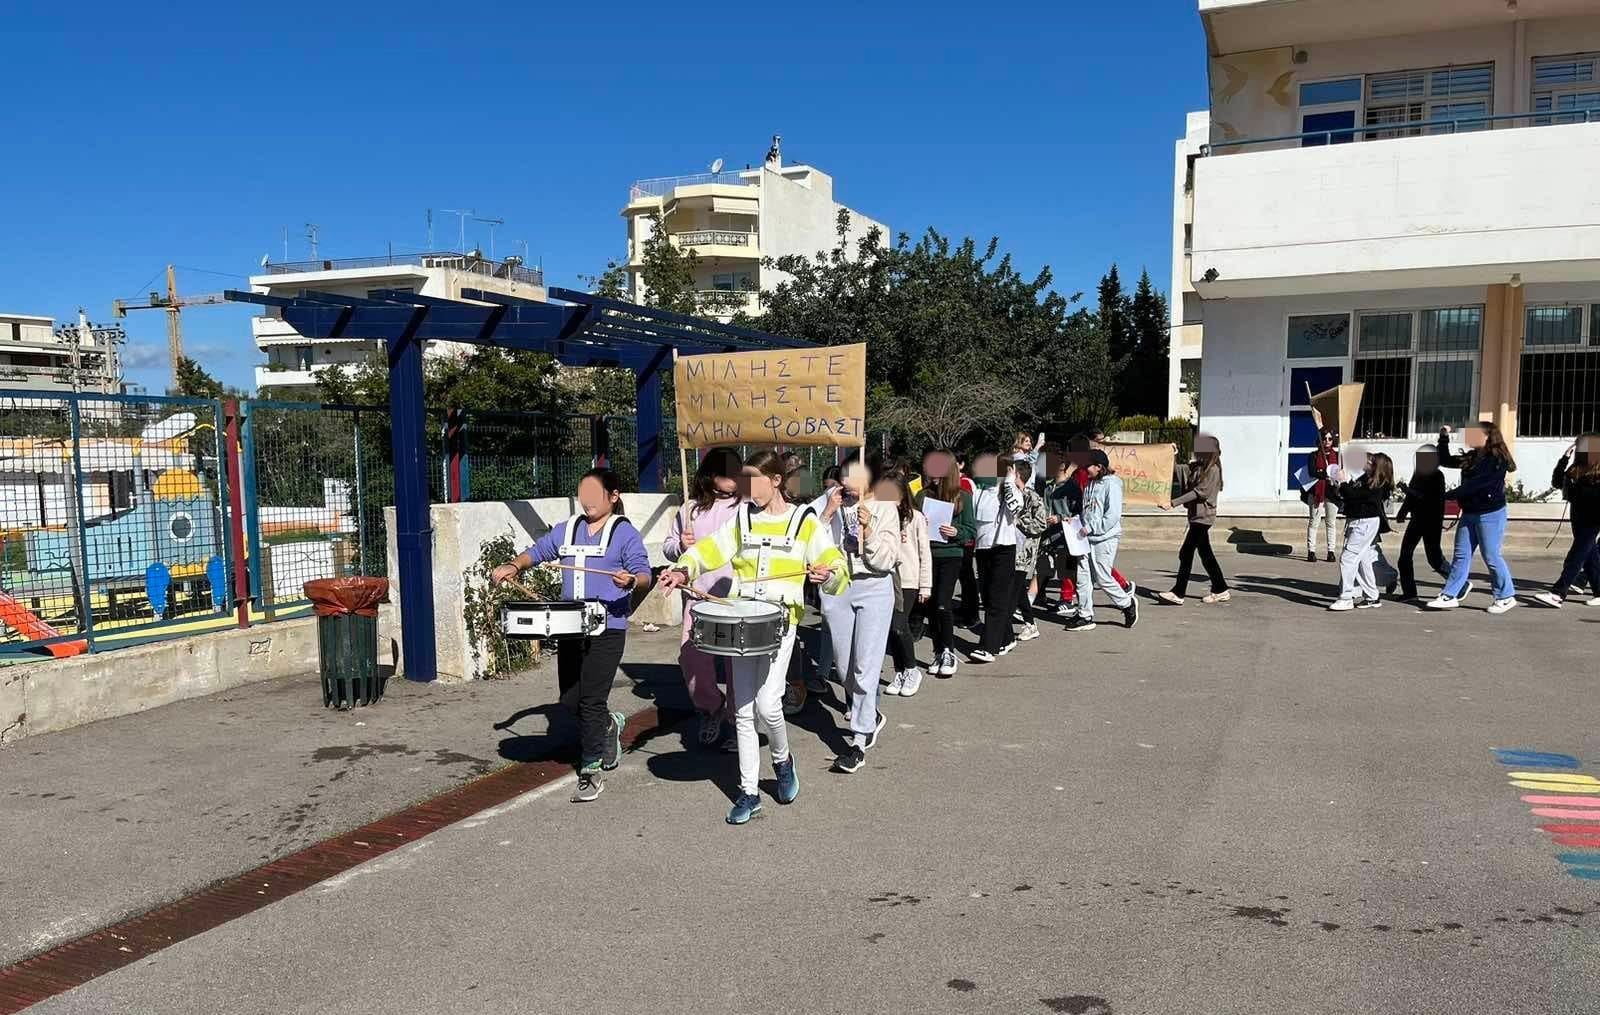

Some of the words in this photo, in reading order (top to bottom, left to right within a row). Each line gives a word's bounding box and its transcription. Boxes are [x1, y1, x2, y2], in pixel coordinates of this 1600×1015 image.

[686, 354, 845, 382] ΜΙΛΗΣΤΕ
[687, 384, 842, 412] ΜΙΛΗΣΤΕ
[686, 421, 741, 442] ΜΗΝ
